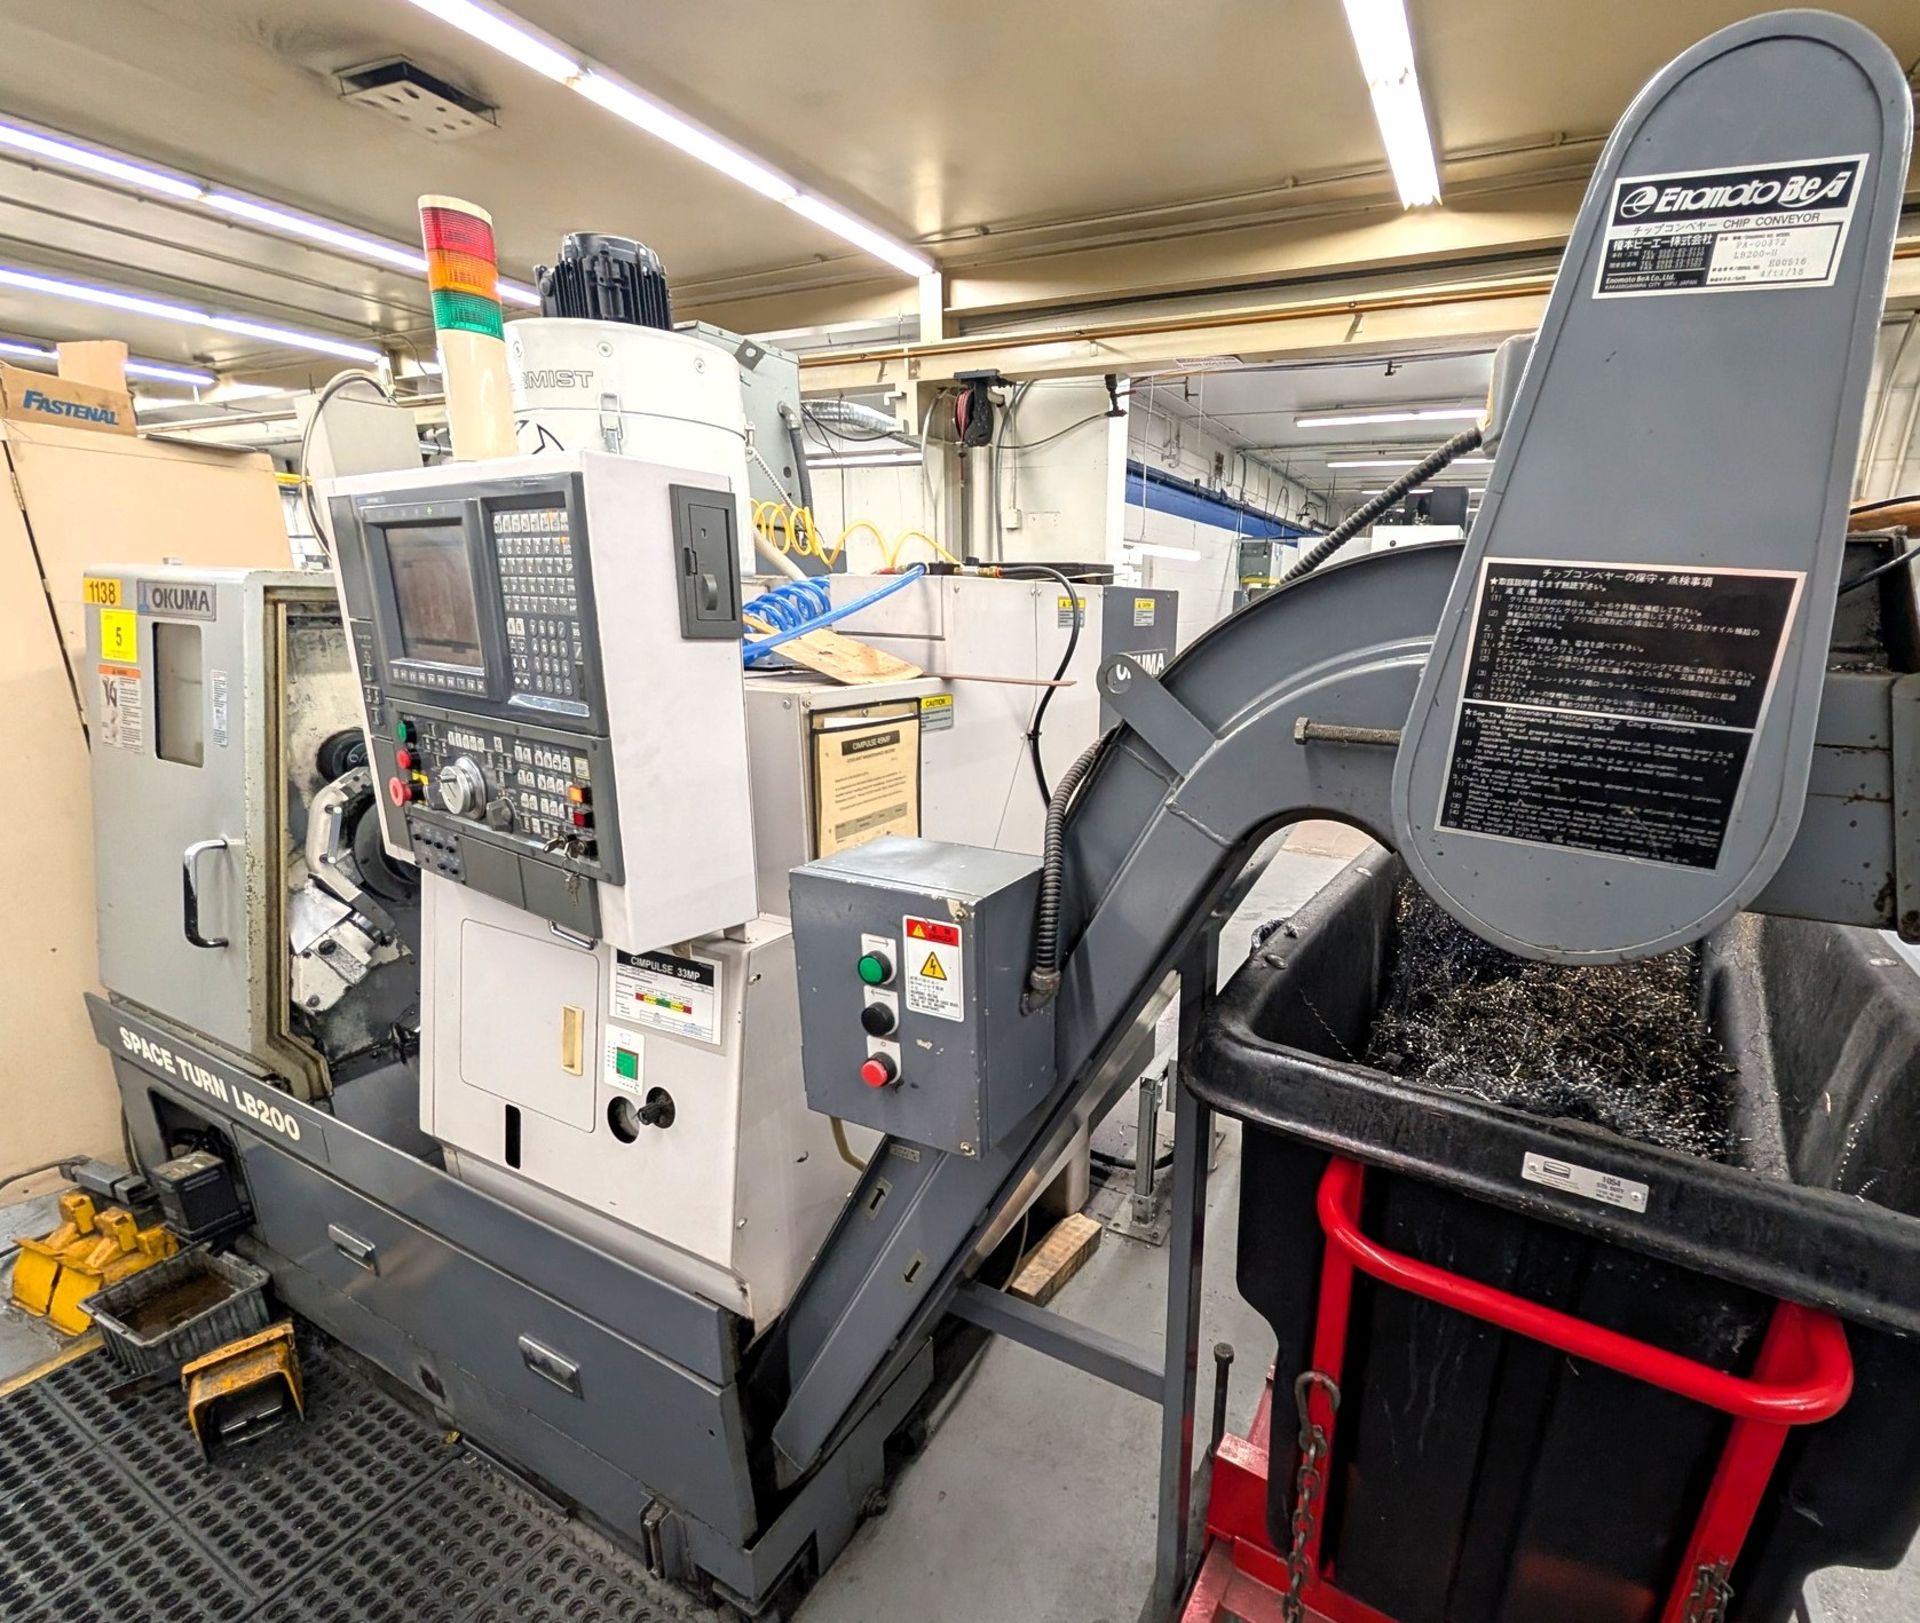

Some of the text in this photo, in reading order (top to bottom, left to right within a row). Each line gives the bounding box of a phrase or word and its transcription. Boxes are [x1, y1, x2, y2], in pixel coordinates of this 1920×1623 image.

[1654, 176, 1783, 213] Enomoto
[1722, 217, 1750, 228] CHIP
[1755, 211, 1821, 226] CONVEYOR
[1605, 275, 1636, 284] Enomoto
[523, 370, 594, 389] MIST
[23, 389, 119, 426] FASTENAL
[89, 581, 116, 604] 1138
[151, 587, 210, 612] OKUMA
[115, 627, 122, 646] 5
[1499, 625, 1531, 634] モーター
[1504, 713, 1546, 723] Maintenance
[1548, 718, 1590, 728] Instructions
[1505, 707, 1552, 718] Maintenance
[1555, 713, 1604, 724] Instructions
[630, 956, 674, 975] CIMPULSE
[677, 967, 701, 981] 33MP
[119, 1026, 301, 1141] SPACE TURN LB200
